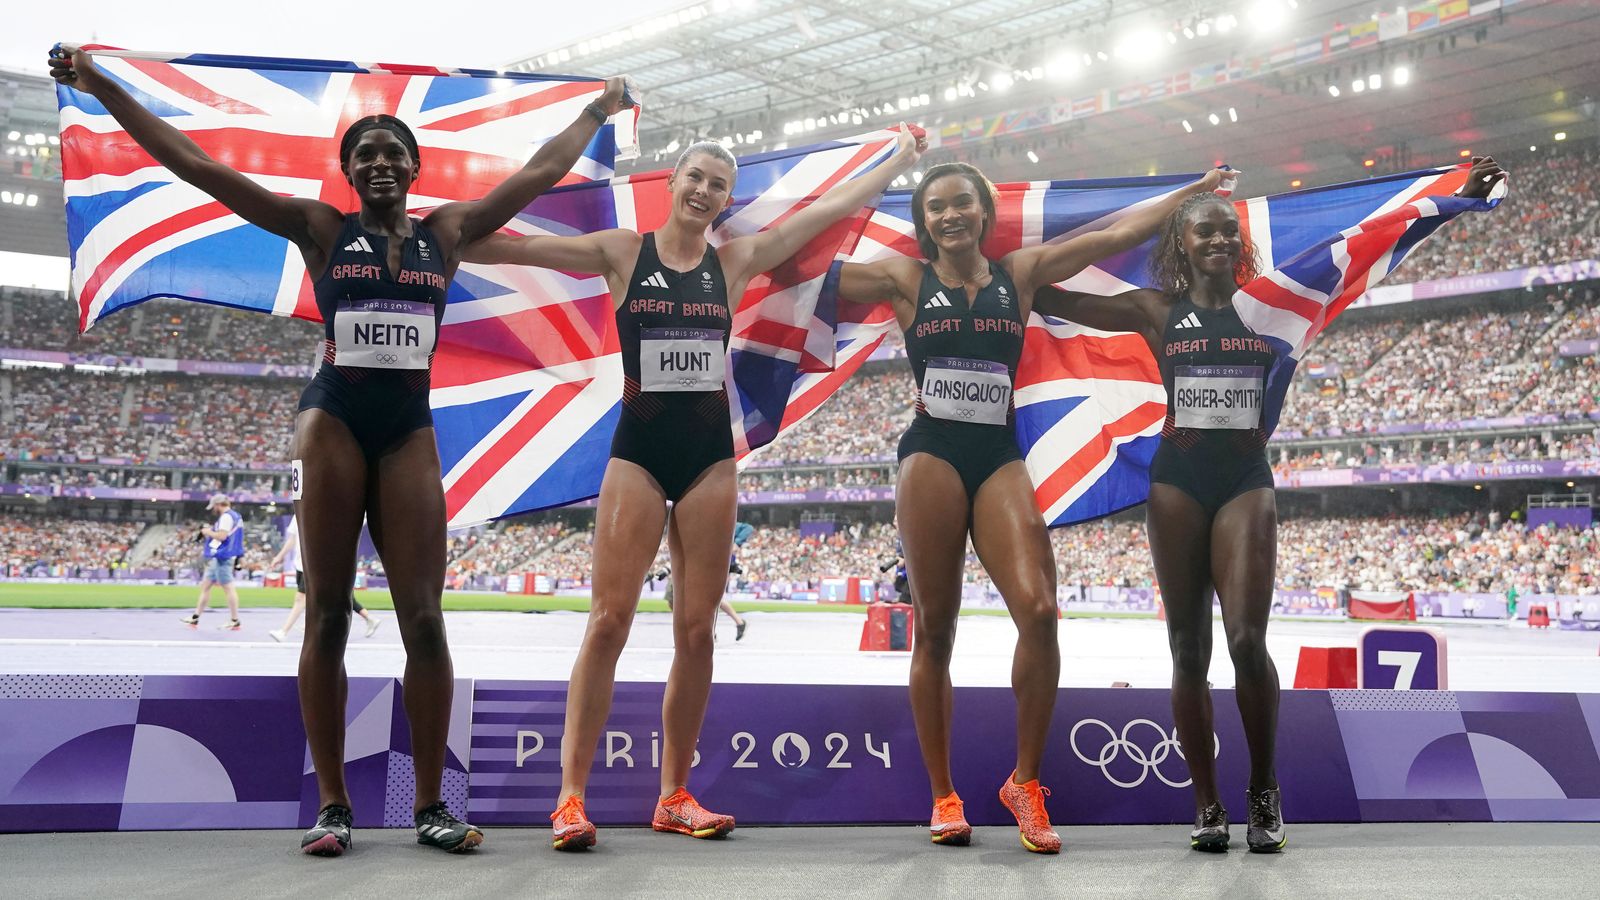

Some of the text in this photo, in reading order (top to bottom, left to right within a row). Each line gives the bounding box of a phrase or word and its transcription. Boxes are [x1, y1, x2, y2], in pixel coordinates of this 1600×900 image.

[332, 264, 382, 280] GREAT
[630, 299, 675, 315] GREAT
[354, 323, 419, 347] NEITA
[916, 318, 962, 338] GREAT
[1165, 338, 1209, 357] GREAT
[660, 351, 711, 372] HUNT
[947, 360, 992, 370] PARIS 2024
[925, 378, 1010, 405] LANSIQUOT
[1177, 388, 1262, 409] ASHER-SMITH
[293, 467, 299, 492] 8
[1378, 650, 1422, 690] 7
[516, 730, 892, 769] PRi 2024
